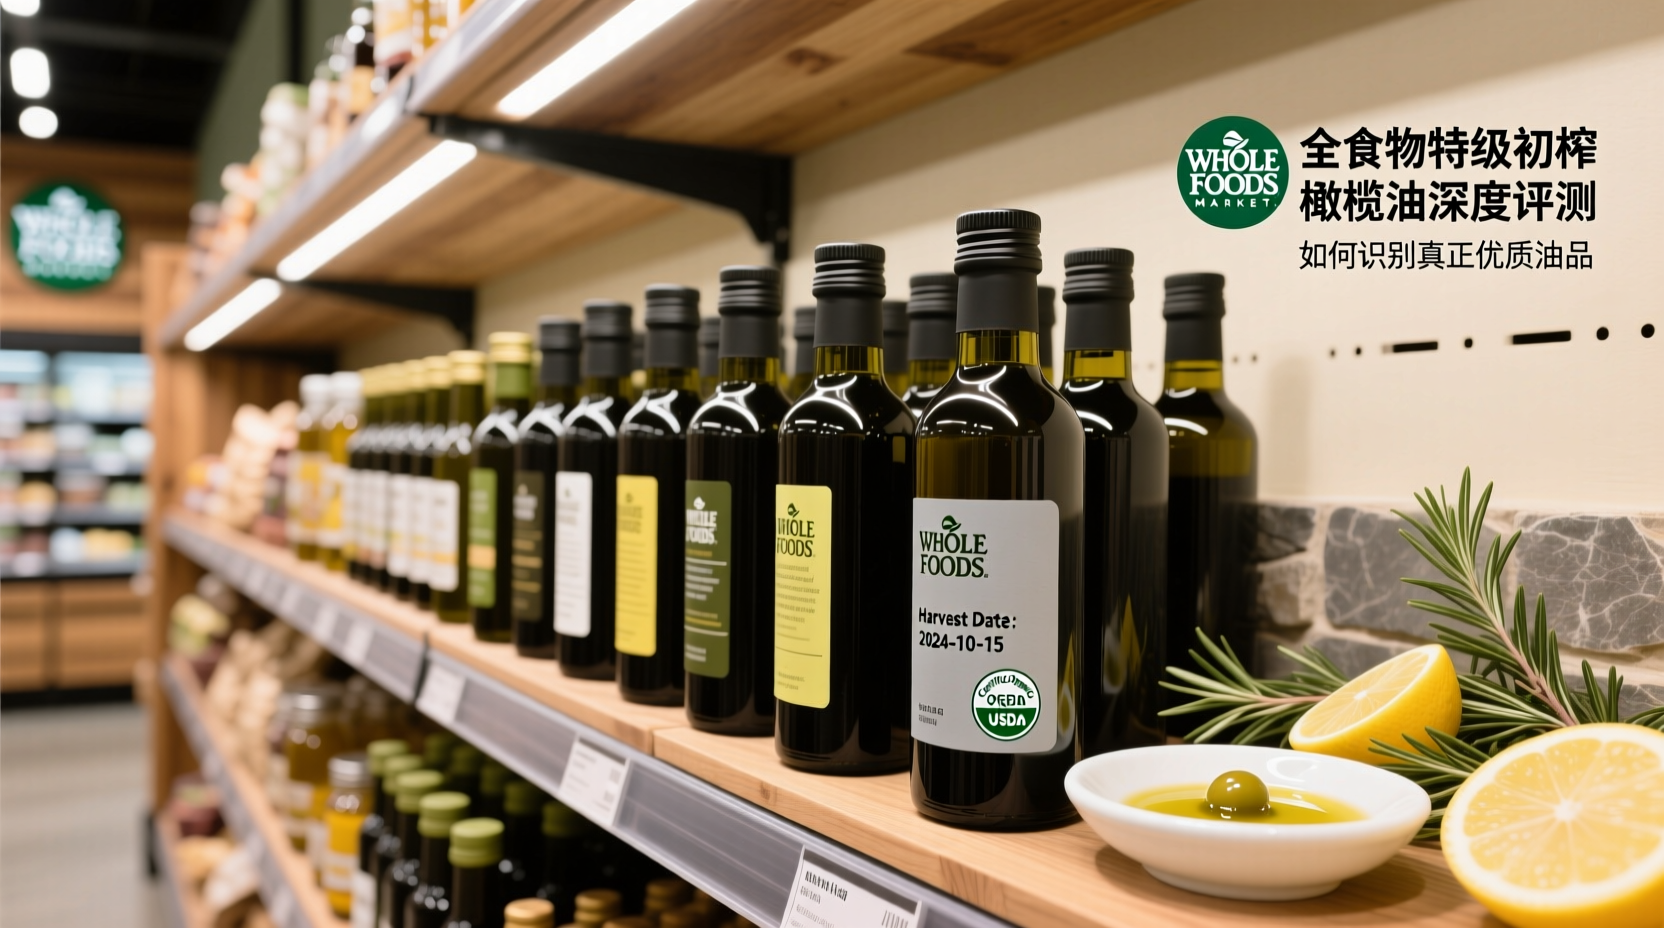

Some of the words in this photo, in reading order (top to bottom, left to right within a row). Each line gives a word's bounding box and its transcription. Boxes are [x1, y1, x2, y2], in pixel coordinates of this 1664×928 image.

[919, 530, 988, 555] WHOLE
[920, 553, 985, 578] FOODS
[918, 606, 969, 627] Harvest
[972, 611, 1017, 629] Date:
[919, 630, 1005, 653] 2024-10-15
